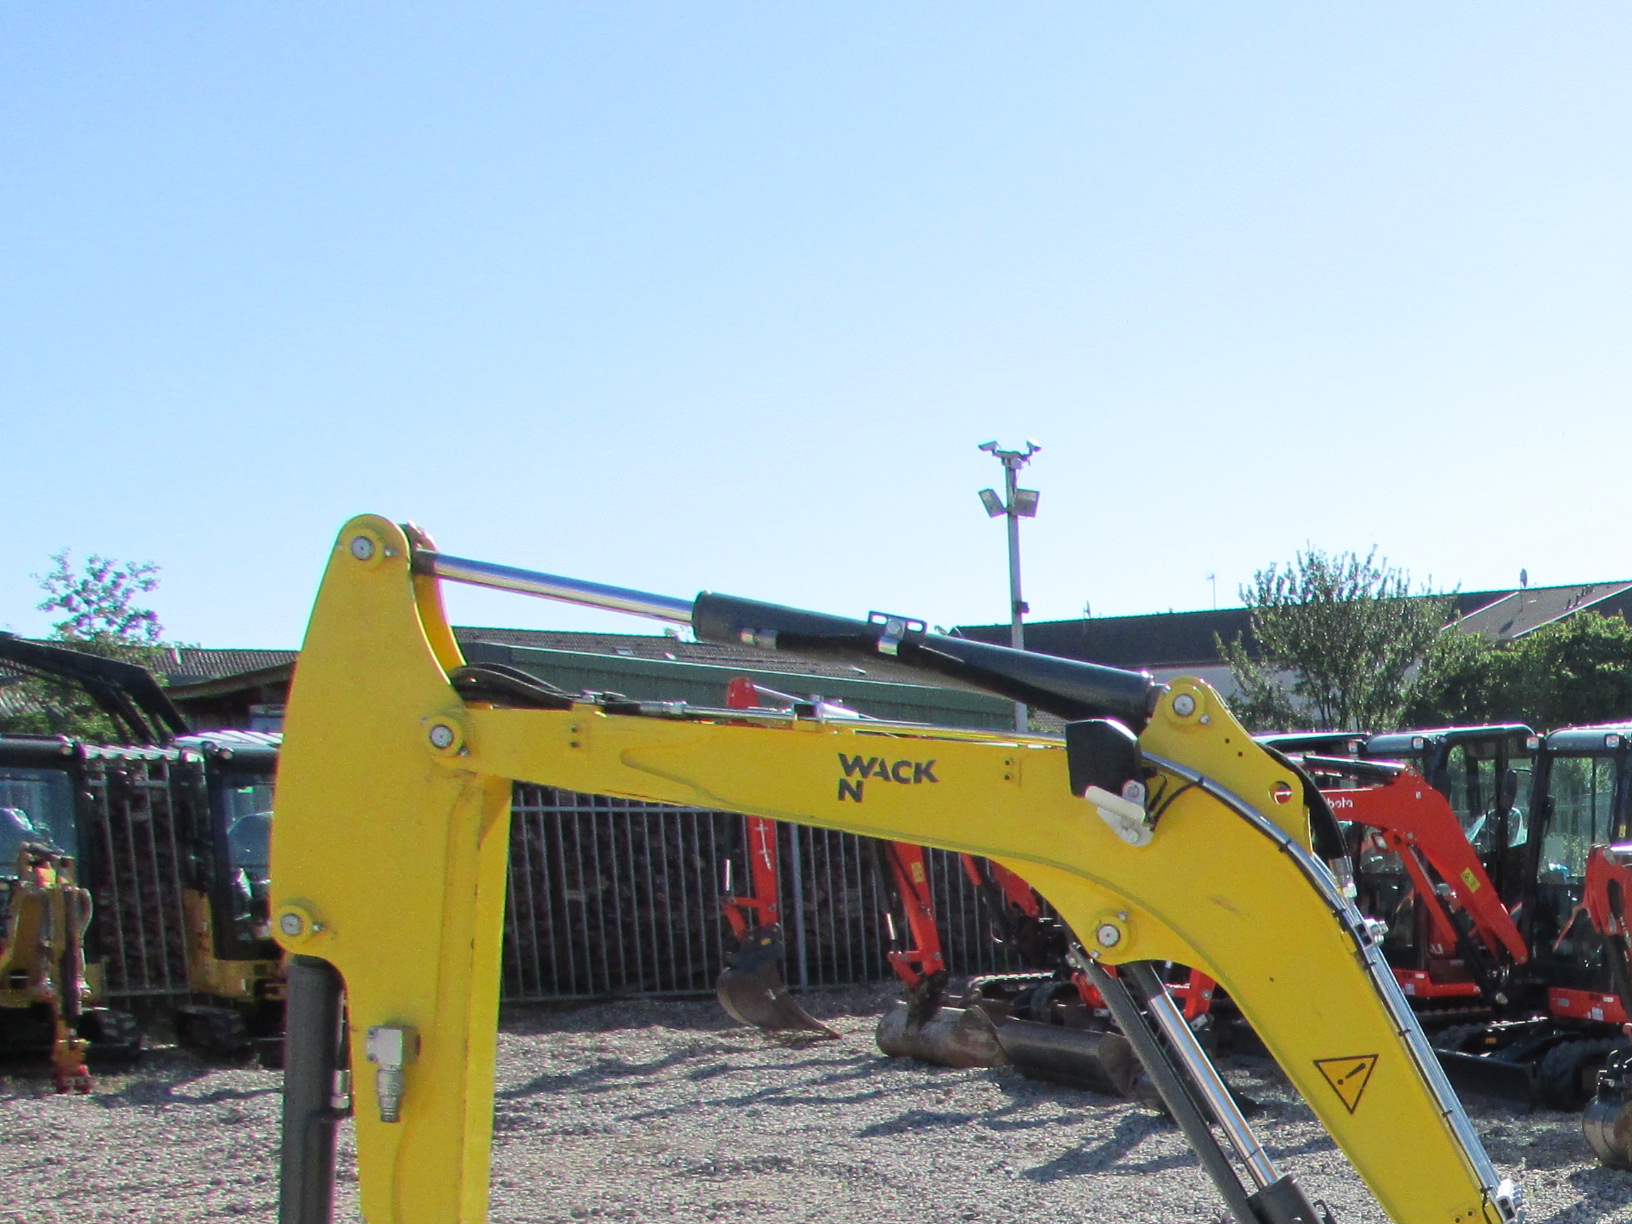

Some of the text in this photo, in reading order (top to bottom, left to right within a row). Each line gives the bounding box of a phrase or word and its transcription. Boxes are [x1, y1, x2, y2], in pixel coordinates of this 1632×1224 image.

[838, 753, 939, 784] WACK
[838, 778, 864, 803] N
[1327, 797, 1353, 809] bota
